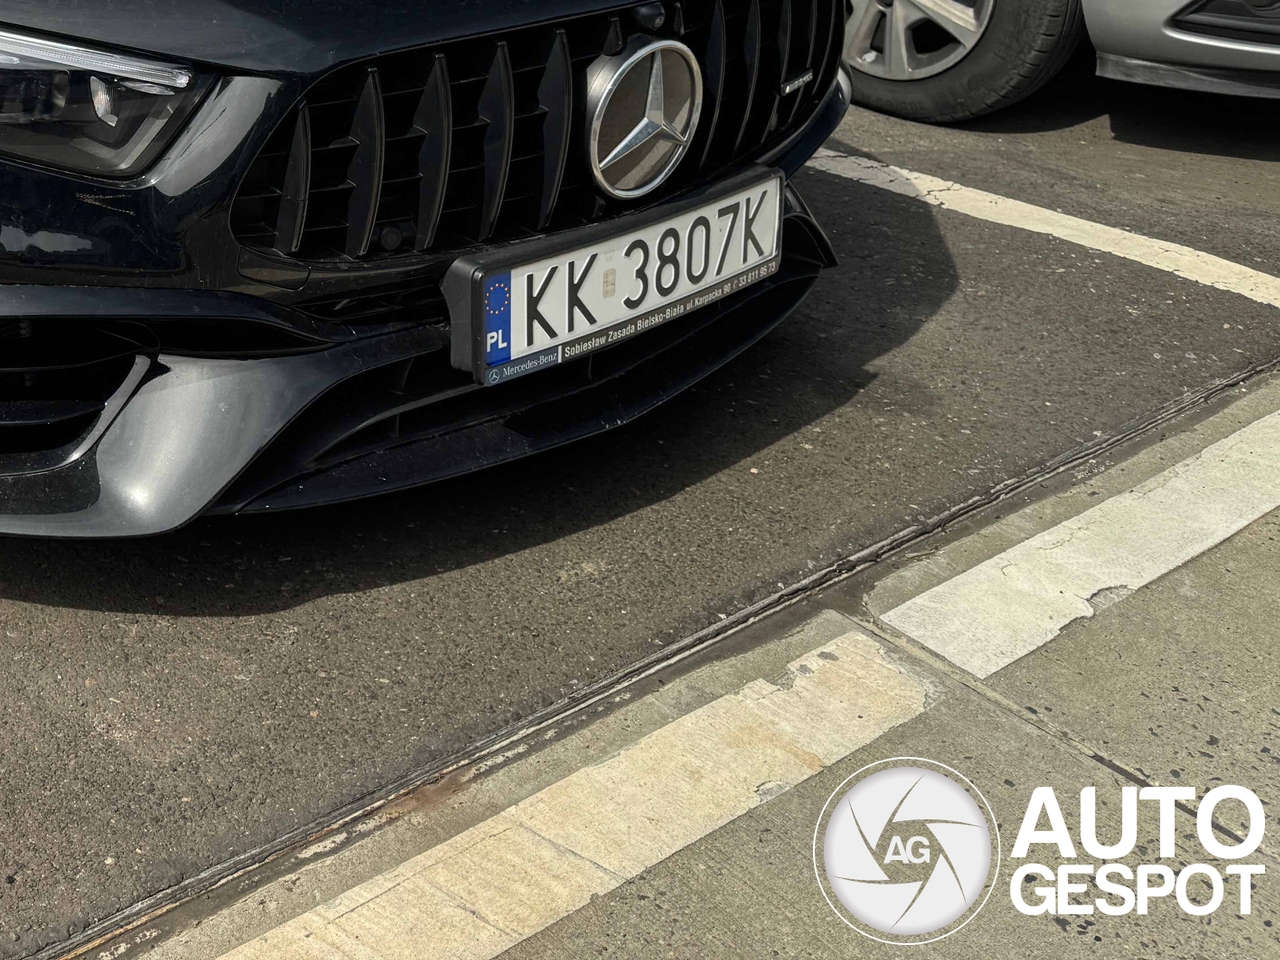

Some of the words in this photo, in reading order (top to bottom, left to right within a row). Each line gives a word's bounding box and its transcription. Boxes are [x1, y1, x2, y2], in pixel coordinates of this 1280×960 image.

[526, 252, 598, 347] KK
[622, 190, 768, 309] 3807K
[564, 335, 606, 358] Sobiesław
[608, 324, 635, 342] Zasada
[637, 304, 684, 331] Bielsko-Biała
[723, 282, 731, 294] 90
[739, 275, 747, 287] 33
[747, 271, 759, 283] 811
[768, 261, 776, 272] 73
[486, 329, 507, 353] PL
[502, 353, 557, 378] Mercedes-Benz
